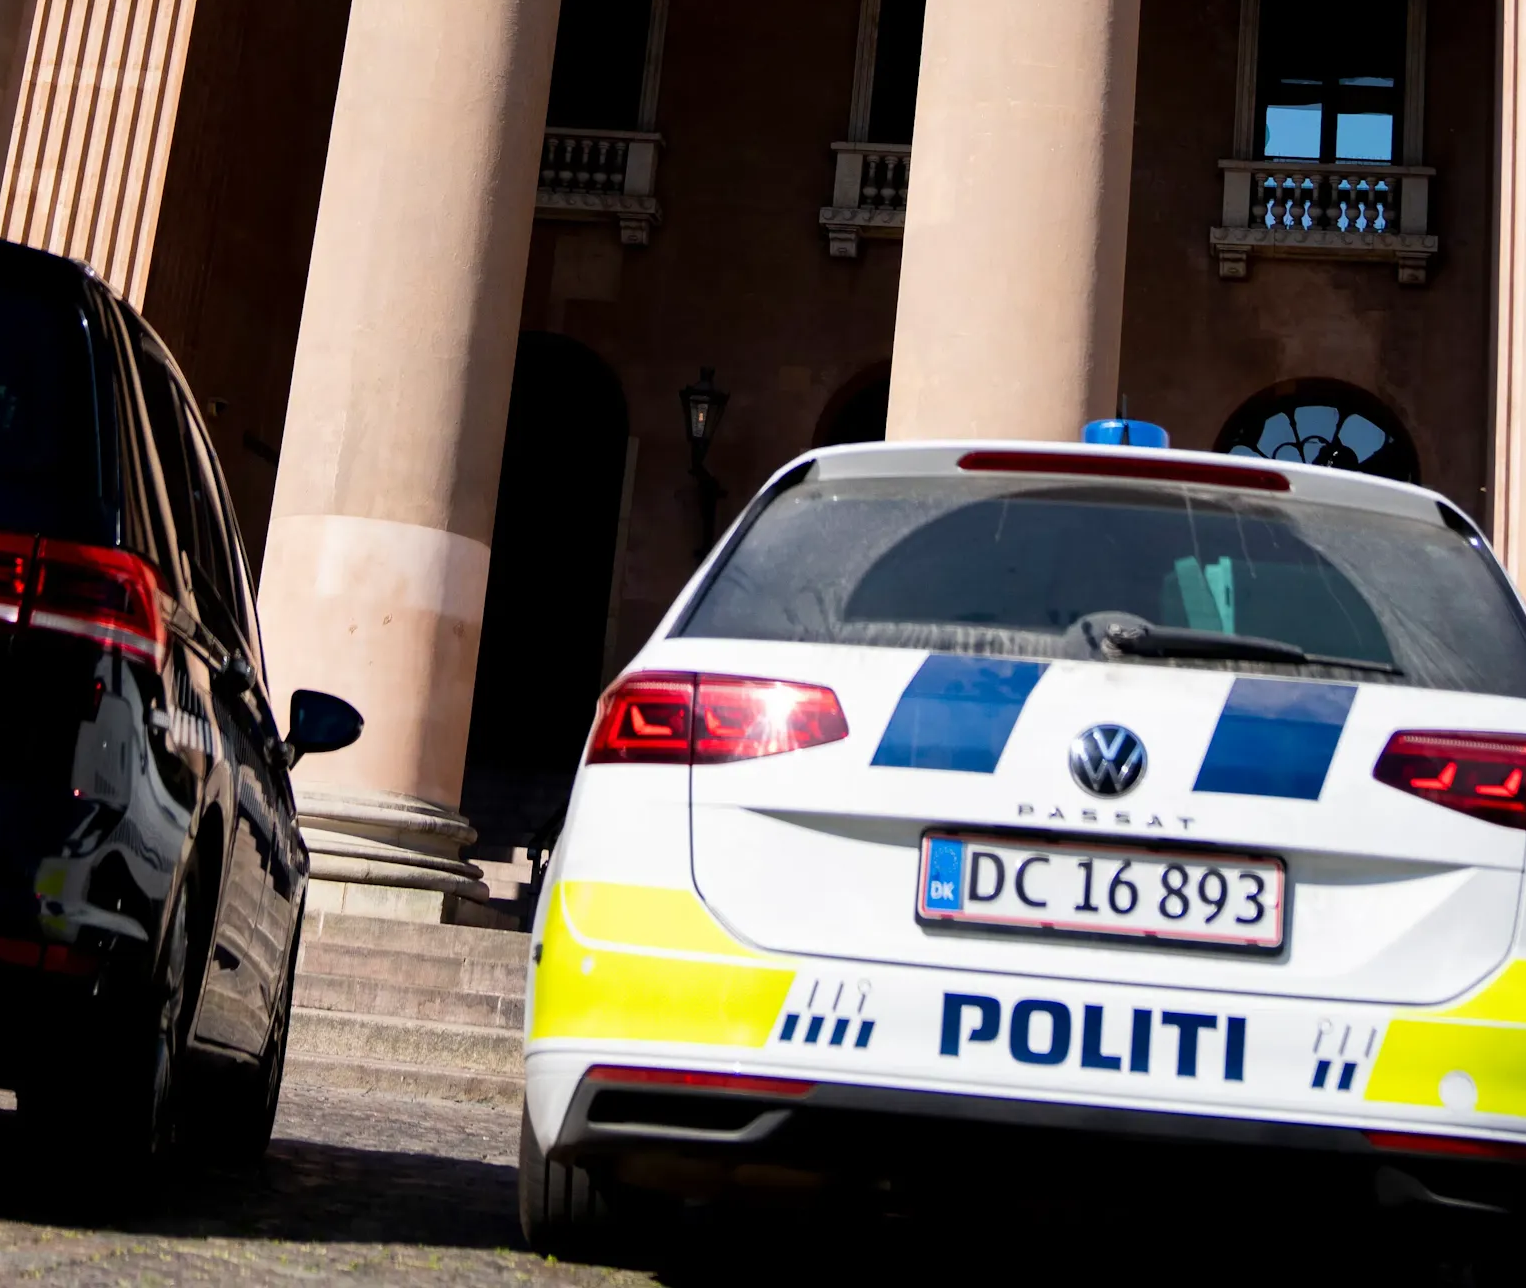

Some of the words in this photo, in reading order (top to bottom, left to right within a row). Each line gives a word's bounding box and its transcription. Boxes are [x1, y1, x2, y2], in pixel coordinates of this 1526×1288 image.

[1017, 803, 1196, 830] PASSAT
[930, 880, 956, 901] DK
[968, 851, 1051, 909] DC
[1074, 858, 1139, 915] 16
[1158, 862, 1266, 925] 893
[939, 992, 1247, 1083] POLITI
